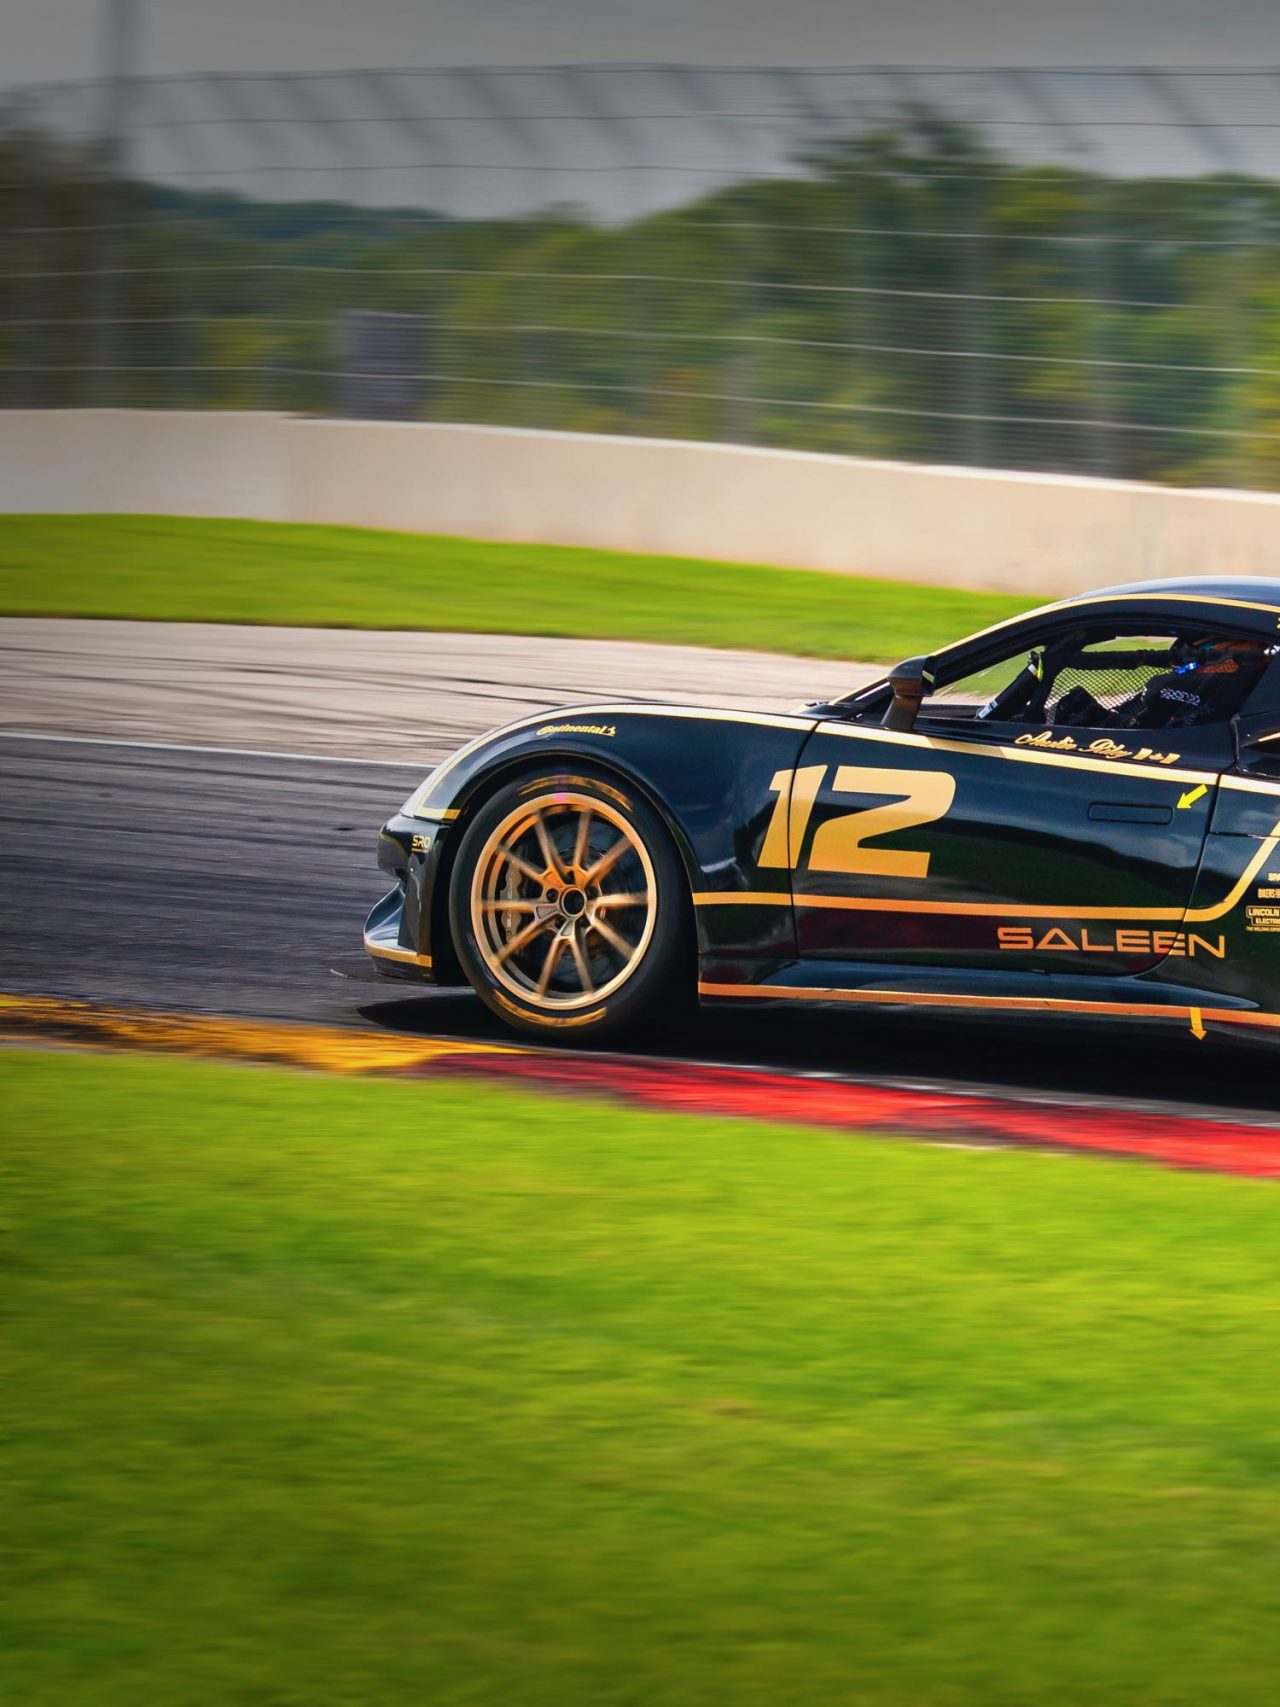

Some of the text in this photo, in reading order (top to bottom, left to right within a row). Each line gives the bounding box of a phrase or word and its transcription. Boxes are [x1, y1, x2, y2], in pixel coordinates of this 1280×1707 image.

[756, 764, 956, 879] 12
[1248, 908, 1280, 916] LINCOLN
[997, 927, 1226, 959] SALEEN
